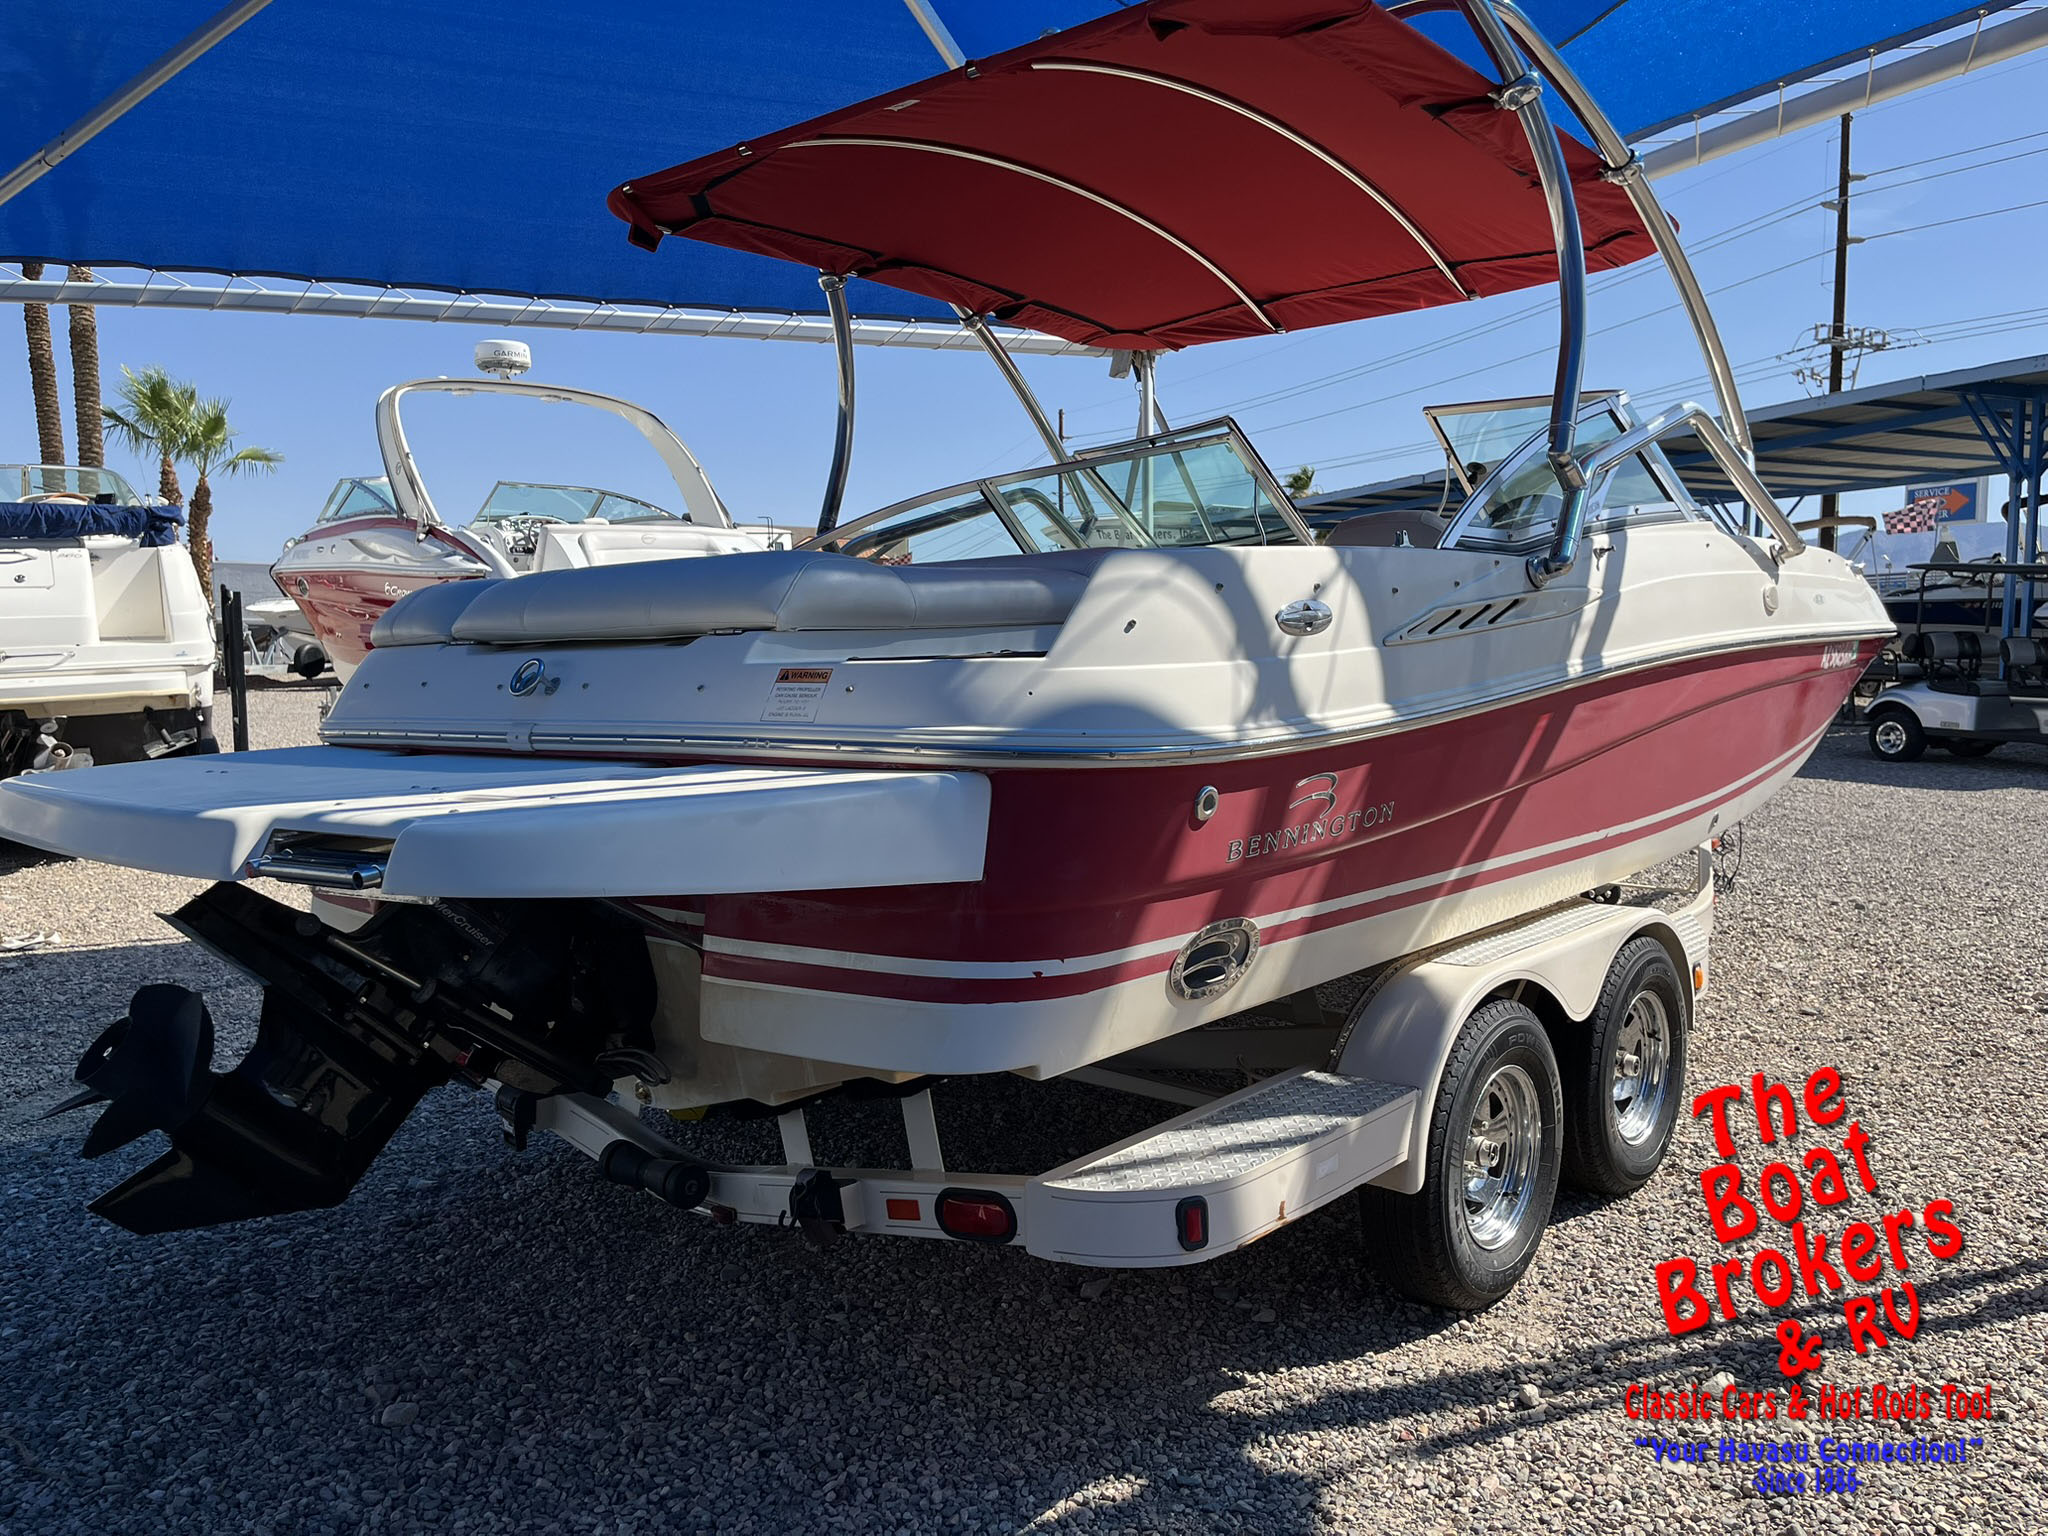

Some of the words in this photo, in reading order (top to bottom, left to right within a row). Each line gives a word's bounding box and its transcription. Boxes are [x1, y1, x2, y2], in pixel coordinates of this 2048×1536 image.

[493, 349, 528, 359] GARMIN
[1914, 487, 1950, 497] SERVICE
[1096, 529, 1111, 540] The
[1114, 529, 1134, 540] Bat
[791, 671, 829, 680] WARNING
[1226, 801, 1395, 864] BENNINGTON
